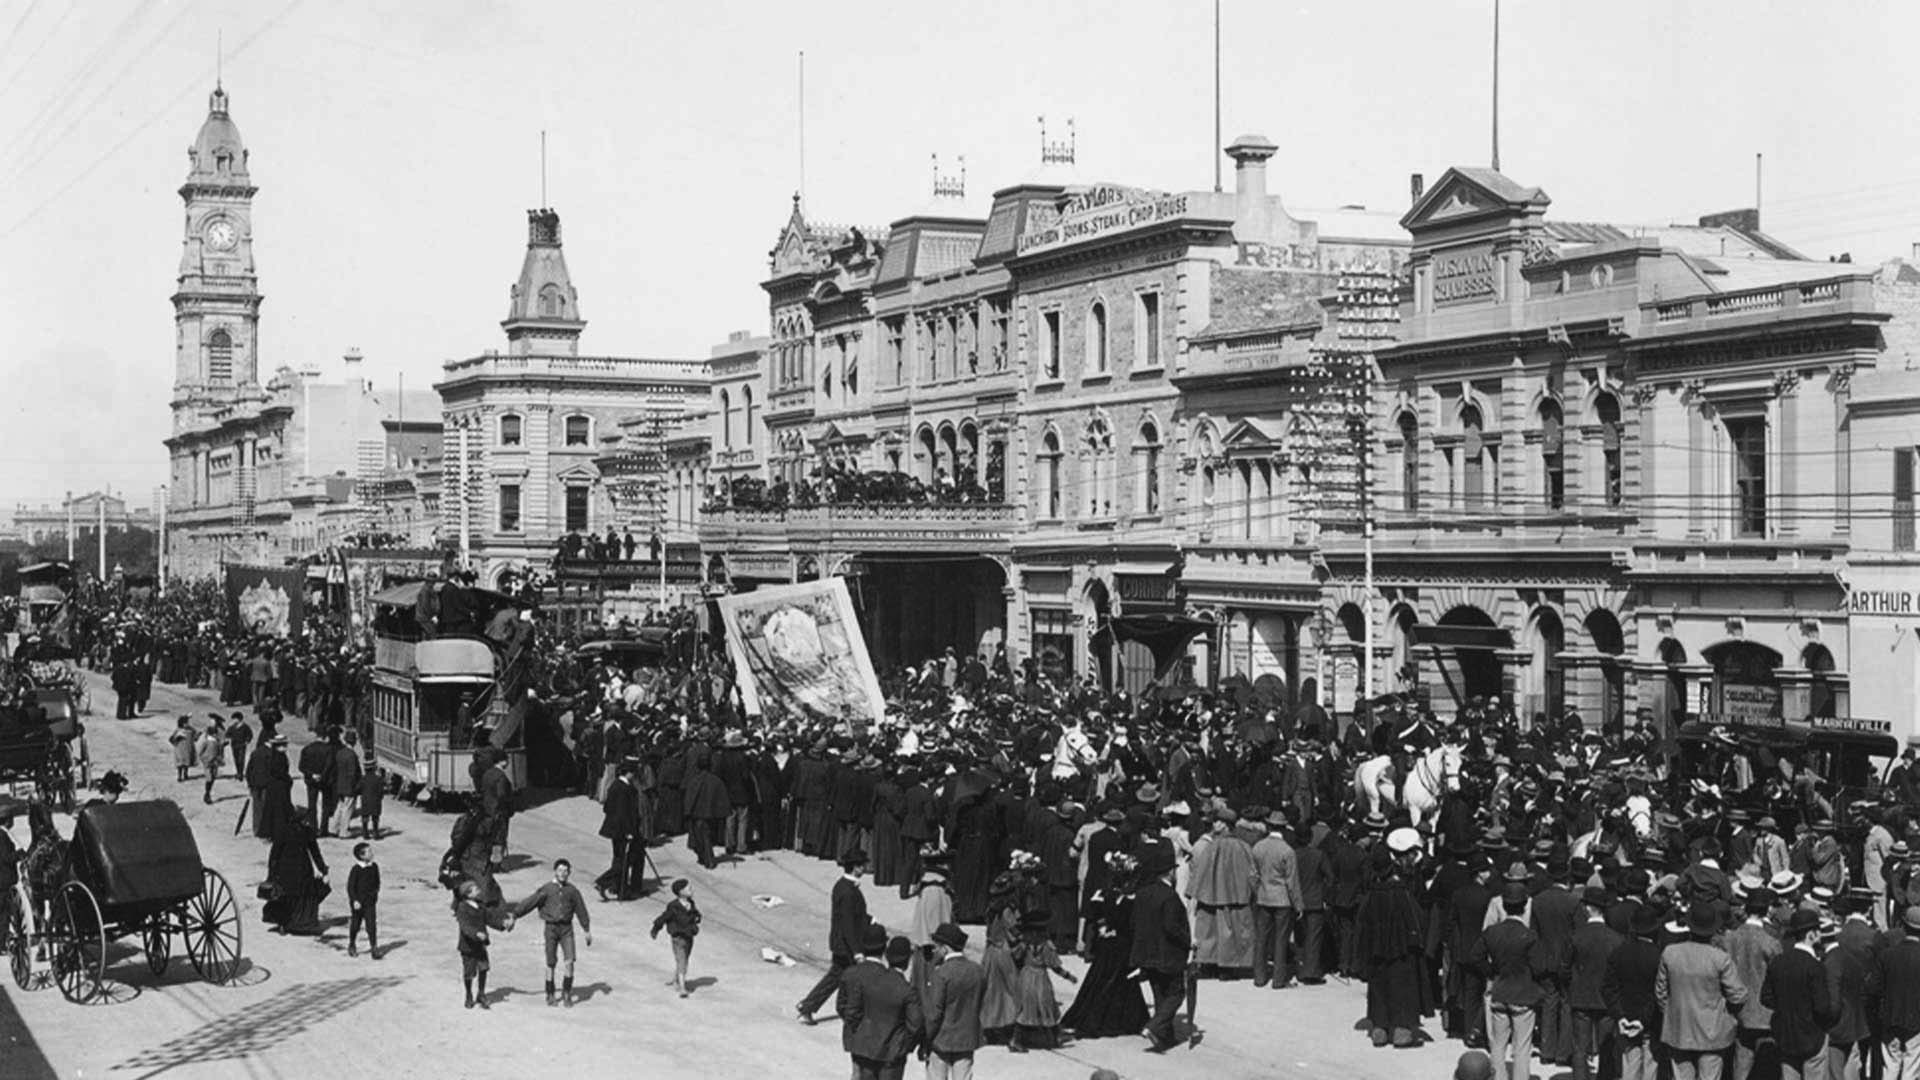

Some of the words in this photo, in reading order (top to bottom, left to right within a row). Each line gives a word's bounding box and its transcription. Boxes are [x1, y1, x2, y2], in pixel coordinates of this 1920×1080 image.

[1090, 213, 1120, 235] STEAK
[1128, 204, 1154, 227] CHOP
[1155, 195, 1188, 222] HOUSE
[1851, 591, 1912, 612] ARTHUR
